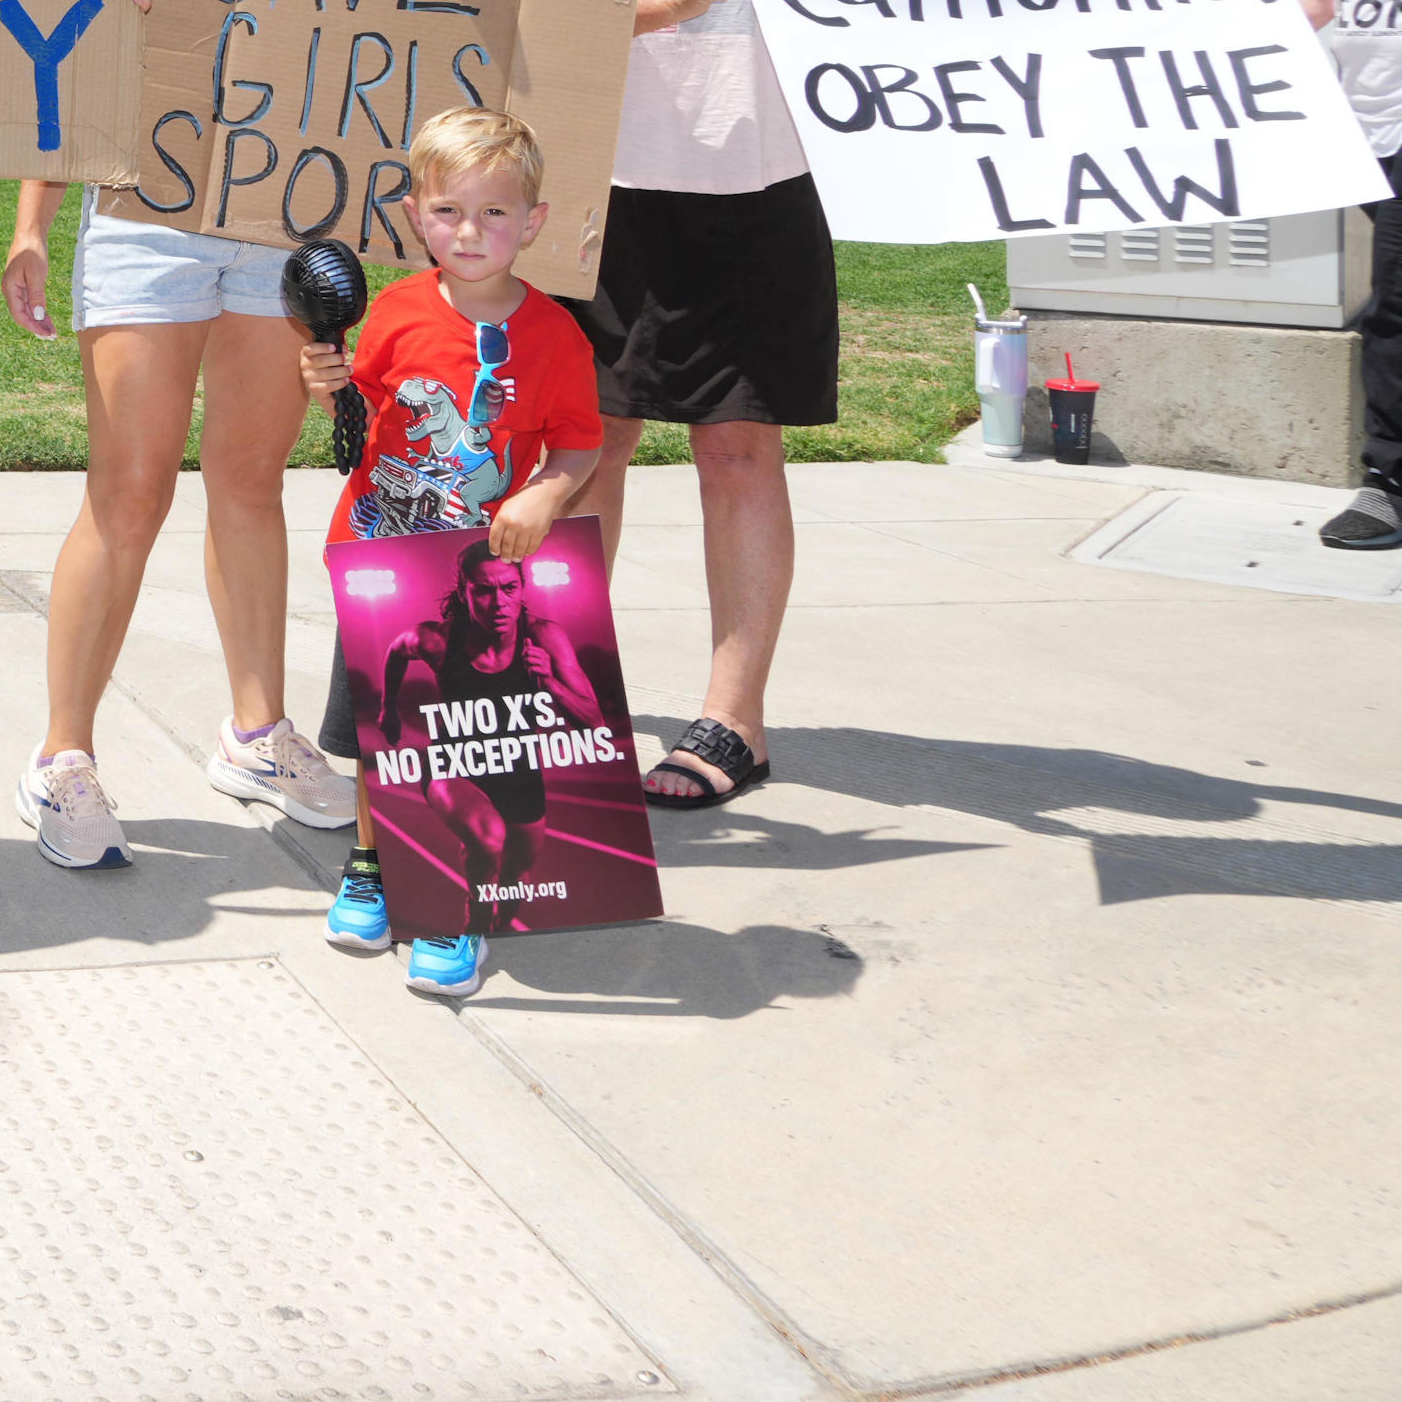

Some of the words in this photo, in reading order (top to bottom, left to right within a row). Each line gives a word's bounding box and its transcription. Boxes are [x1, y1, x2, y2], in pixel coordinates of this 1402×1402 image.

[804, 52, 1044, 139] OBEY
[1089, 44, 1307, 131] THE
[134, 110, 413, 260] SPOR
[977, 138, 1242, 233] LAW
[419, 697, 498, 740] TWO
[502, 691, 565, 732] X'S.
[375, 747, 422, 785] NO
[426, 726, 625, 780] EXCEPTIONS.
[476, 881, 568, 903] XXonly.org
